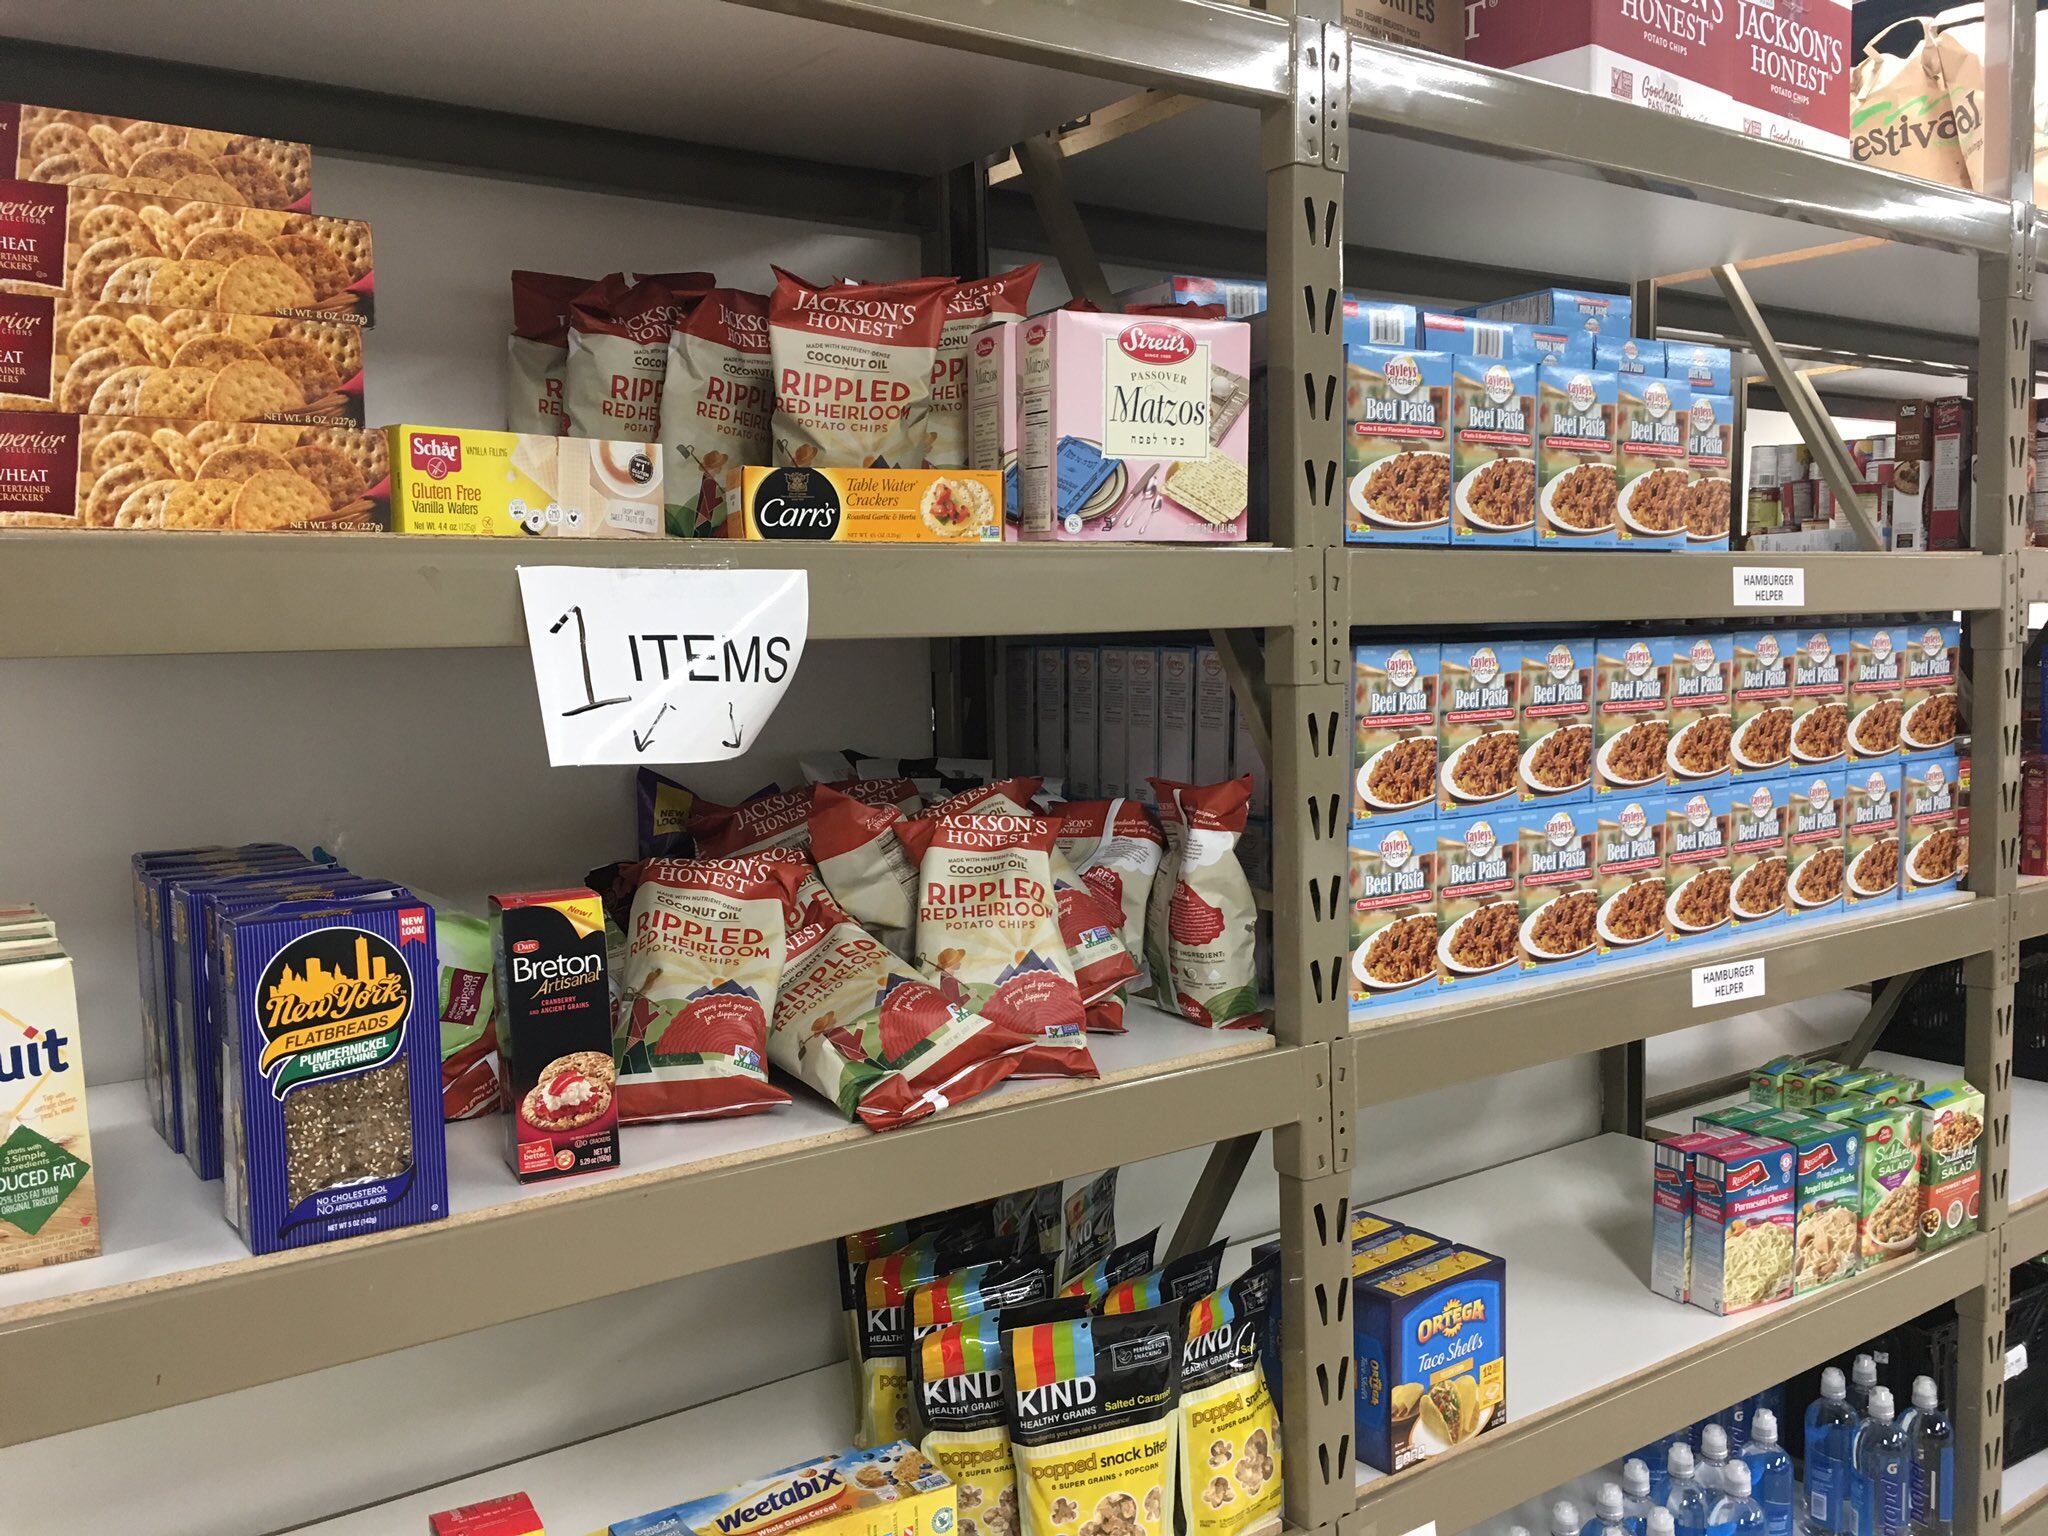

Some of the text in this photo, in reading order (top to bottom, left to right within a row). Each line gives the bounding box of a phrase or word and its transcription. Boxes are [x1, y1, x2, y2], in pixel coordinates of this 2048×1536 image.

[1735, 0, 1842, 75] JACKSON'S
[1751, 44, 1829, 95] HONEST
[275, 307, 322, 318] NET 8
[793, 290, 917, 326] JACKSON'S
[806, 311, 899, 339] HONEST
[824, 343, 840, 351] WITH
[1123, 327, 1189, 355] Streit's
[806, 350, 888, 369] COCONUT OIL
[781, 368, 911, 403] RIPPLED
[1131, 371, 1187, 384] PASSOVER
[602, 401, 636, 419] RED
[696, 402, 730, 421] RED
[776, 396, 912, 420] RED HEIRLOOM
[1110, 385, 1205, 426] Matzos
[1366, 398, 1435, 423] Beef Pasta
[264, 412, 281, 421] NET
[305, 415, 311, 423] 8
[798, 418, 888, 433] POTATO CHIPS
[1470, 407, 1525, 431] Beef Pasta
[1554, 415, 1606, 437] Beef Pasta
[1631, 421, 1679, 443] Beef Pasta
[6, 447, 57, 455] SELECTIONS
[413, 437, 458, 461] Schär
[412, 482, 482, 501] Gluten Free
[847, 478, 915, 492] Table Water
[412, 500, 479, 515] Vanilla Wafers
[846, 493, 899, 506] Crackers
[760, 499, 836, 528] Carr's
[290, 520, 307, 530] NET
[331, 521, 337, 530] 8
[414, 521, 424, 530] Net
[1743, 574, 1794, 586] HAMBURGER
[1755, 590, 1783, 601] HELPER
[550, 605, 790, 716] 1 ITEMS
[1456, 688, 1508, 709] Beef Pasta
[1533, 683, 1583, 703] Beef Pasta
[1610, 682, 1634, 699] Beef
[1371, 692, 1427, 713] Beef Pasta
[947, 830, 1032, 847] HONEST
[645, 856, 770, 884] JACKSON'S
[950, 860, 1026, 874] COCONUT OIL
[658, 867, 749, 893] HONEST
[928, 878, 1045, 906] RIPPLED
[567, 905, 593, 919] New!
[657, 896, 739, 920] COCONUT OIL
[921, 907, 957, 922] RED
[401, 916, 424, 926] NEW
[402, 925, 425, 936] LOOK!
[636, 910, 764, 945] RIPPLED
[946, 919, 1035, 930] POTATO CHIPS
[517, 943, 535, 951] Dare
[631, 931, 770, 959] RED HEIRLOOM
[648, 944, 739, 966] POTATO CHIPS
[513, 954, 601, 982] Breton
[1703, 964, 1755, 984] HAMBURGER
[530, 966, 599, 999] Artisanal
[773, 939, 876, 1020] RIPPLED
[1024, 981, 1055, 991] and great
[1715, 982, 1744, 997] HELPER
[541, 996, 576, 1006] CRANBERRY
[541, 1002, 589, 1014] ANCIENT GRAINS
[718, 1001, 752, 1012] and great
[717, 1011, 747, 1022] dipping!
[285, 1015, 389, 1049] FLATBREADS
[300, 1037, 389, 1067] PUMPERNICKEL
[312, 1050, 378, 1072] EVERYTHING
[589, 1136, 611, 1144] CRACKERS
[4, 1150, 46, 1164] 3 Simple
[580, 1157, 591, 1165] 5.29
[594, 1148, 603, 1156] NET
[2, 1158, 50, 1172] Ingredients
[53, 1162, 77, 1181] FAT
[1878, 1160, 1910, 1177] SALAD
[1941, 1161, 1972, 1179] SALAD
[29, 1185, 59, 1200] FAT THAN
[317, 1186, 387, 1206] NO CHOLESTEROL
[1804, 1182, 1821, 1196] Angel
[32, 1195, 58, 1208] TRISCUIT
[317, 1196, 387, 1216] NO ARTIFICIAL FLAVORS
[1734, 1192, 1789, 1213] Parmesan Cheese
[1418, 1298, 1485, 1344] ORTEGA
[1133, 1349, 1162, 1360] SNACKING
[1182, 1324, 1232, 1366] KIND
[1418, 1352, 1444, 1373] Taco
[1447, 1333, 1484, 1361] Shells
[1483, 1365, 1492, 1378] 12
[923, 1371, 1004, 1405] KIND
[1017, 1376, 1097, 1417] KIND
[928, 1400, 1004, 1415] HEALTHY GRAINS
[1105, 1388, 1170, 1412] Salted Caramel
[1020, 1407, 1097, 1429] HEALTHY GRAINS
[1192, 1394, 1243, 1428] popped
[939, 1443, 1004, 1467] popped
[1032, 1439, 1167, 1480] popped snack bites
[966, 1469, 991, 1477] SUPER
[1059, 1462, 1159, 1490] SUPER GRAINS POPCORN
[715, 1468, 843, 1533] Weetabix
[784, 1503, 837, 1528] Grain Cereal
